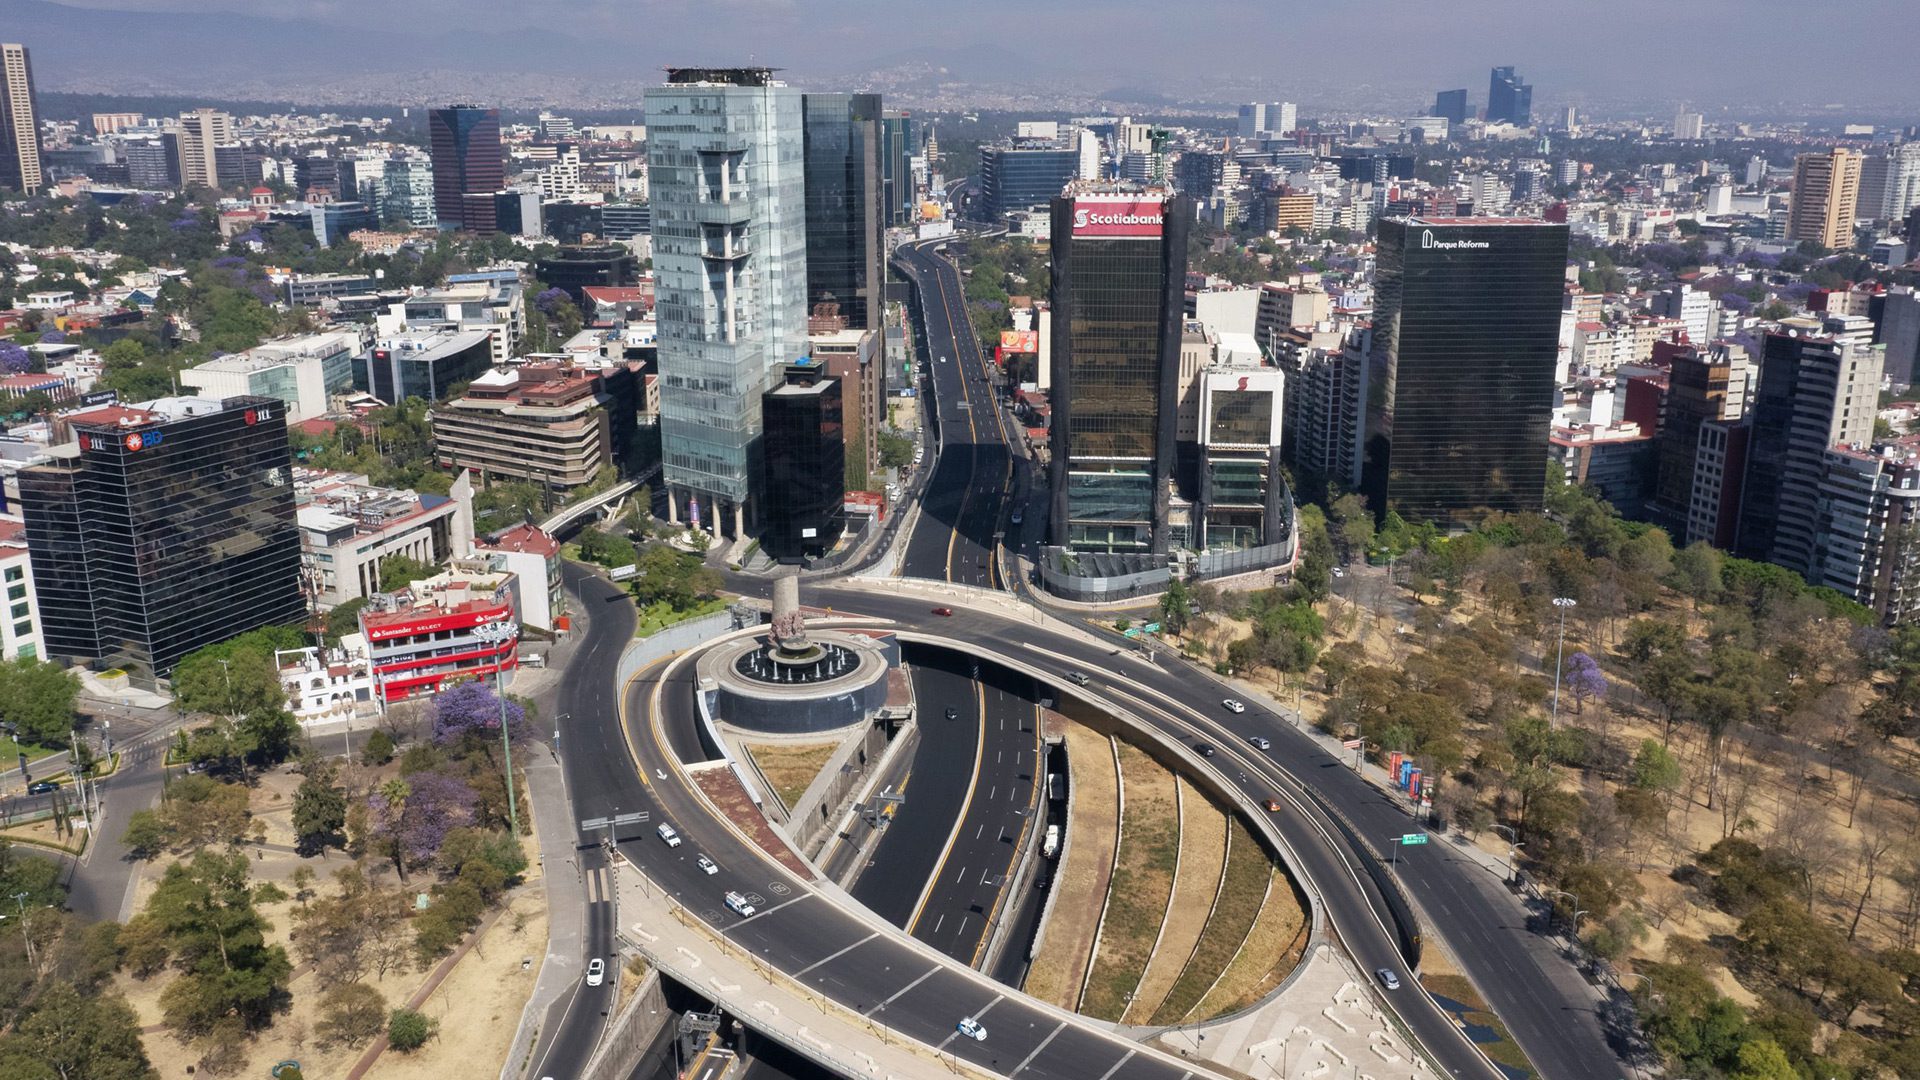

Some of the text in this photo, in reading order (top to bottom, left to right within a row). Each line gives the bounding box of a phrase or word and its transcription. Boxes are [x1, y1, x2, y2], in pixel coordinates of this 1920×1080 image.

[1090, 213, 1163, 225] Scotiabank
[1433, 240, 1489, 250] Parque Reforma
[257, 409, 272, 422] JLL
[90, 438, 104, 450] JLL
[381, 623, 442, 636] Santander SELECT
